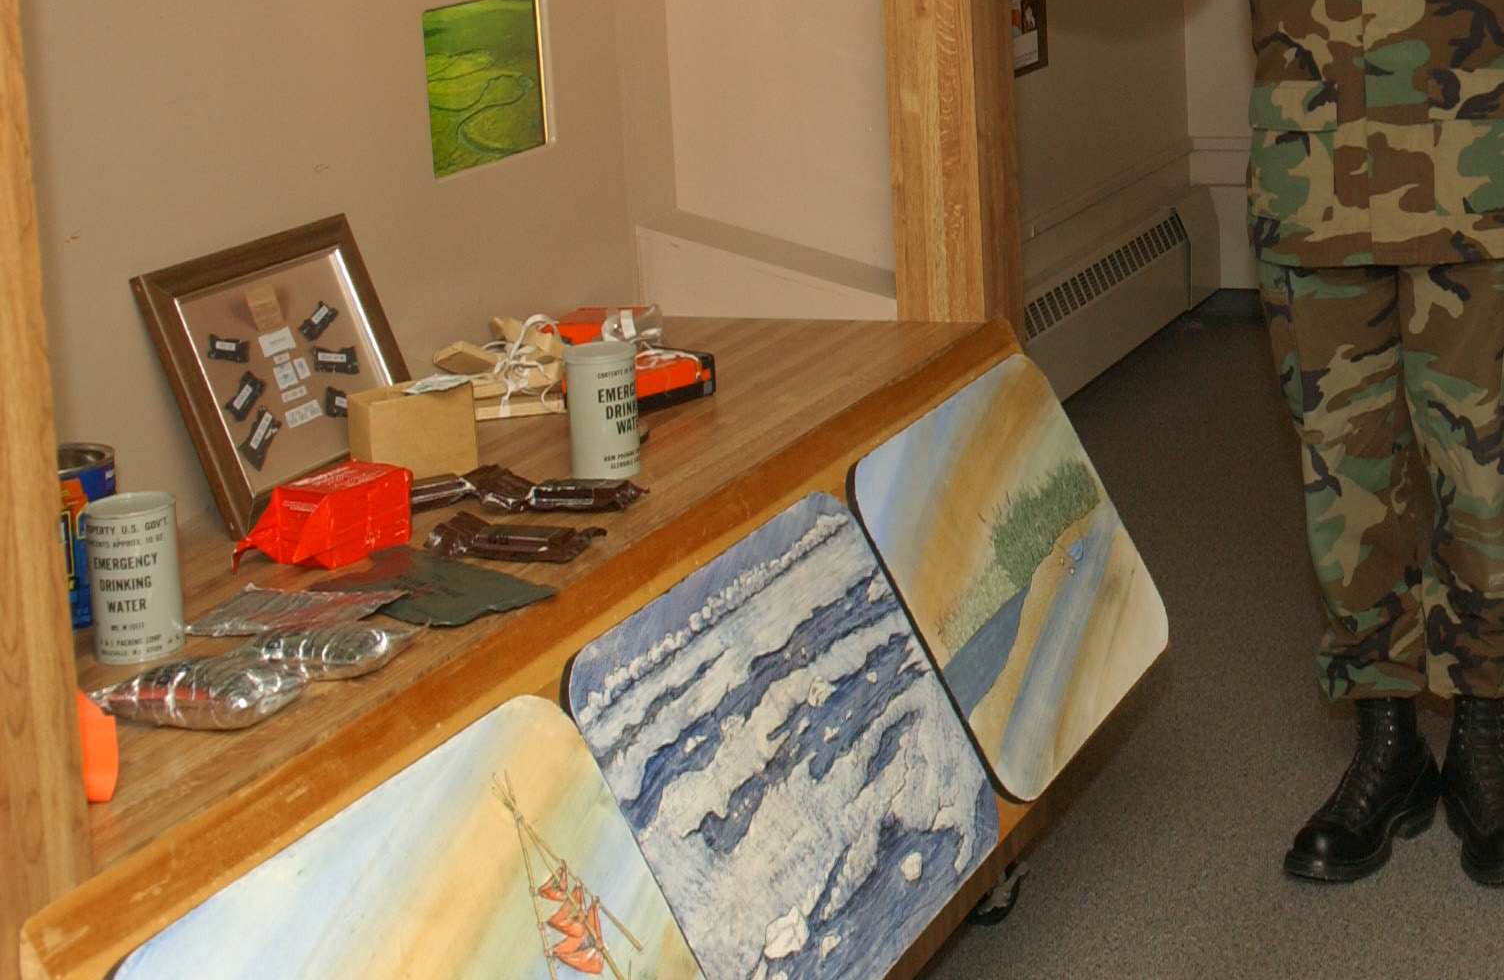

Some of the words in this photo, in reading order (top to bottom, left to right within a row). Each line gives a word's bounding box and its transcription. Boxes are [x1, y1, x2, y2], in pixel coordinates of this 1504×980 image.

[121, 524, 139, 536] U.S.
[93, 552, 158, 571] EMERGENCY
[99, 575, 152, 592] DRINKING
[107, 597, 147, 613] WATER
